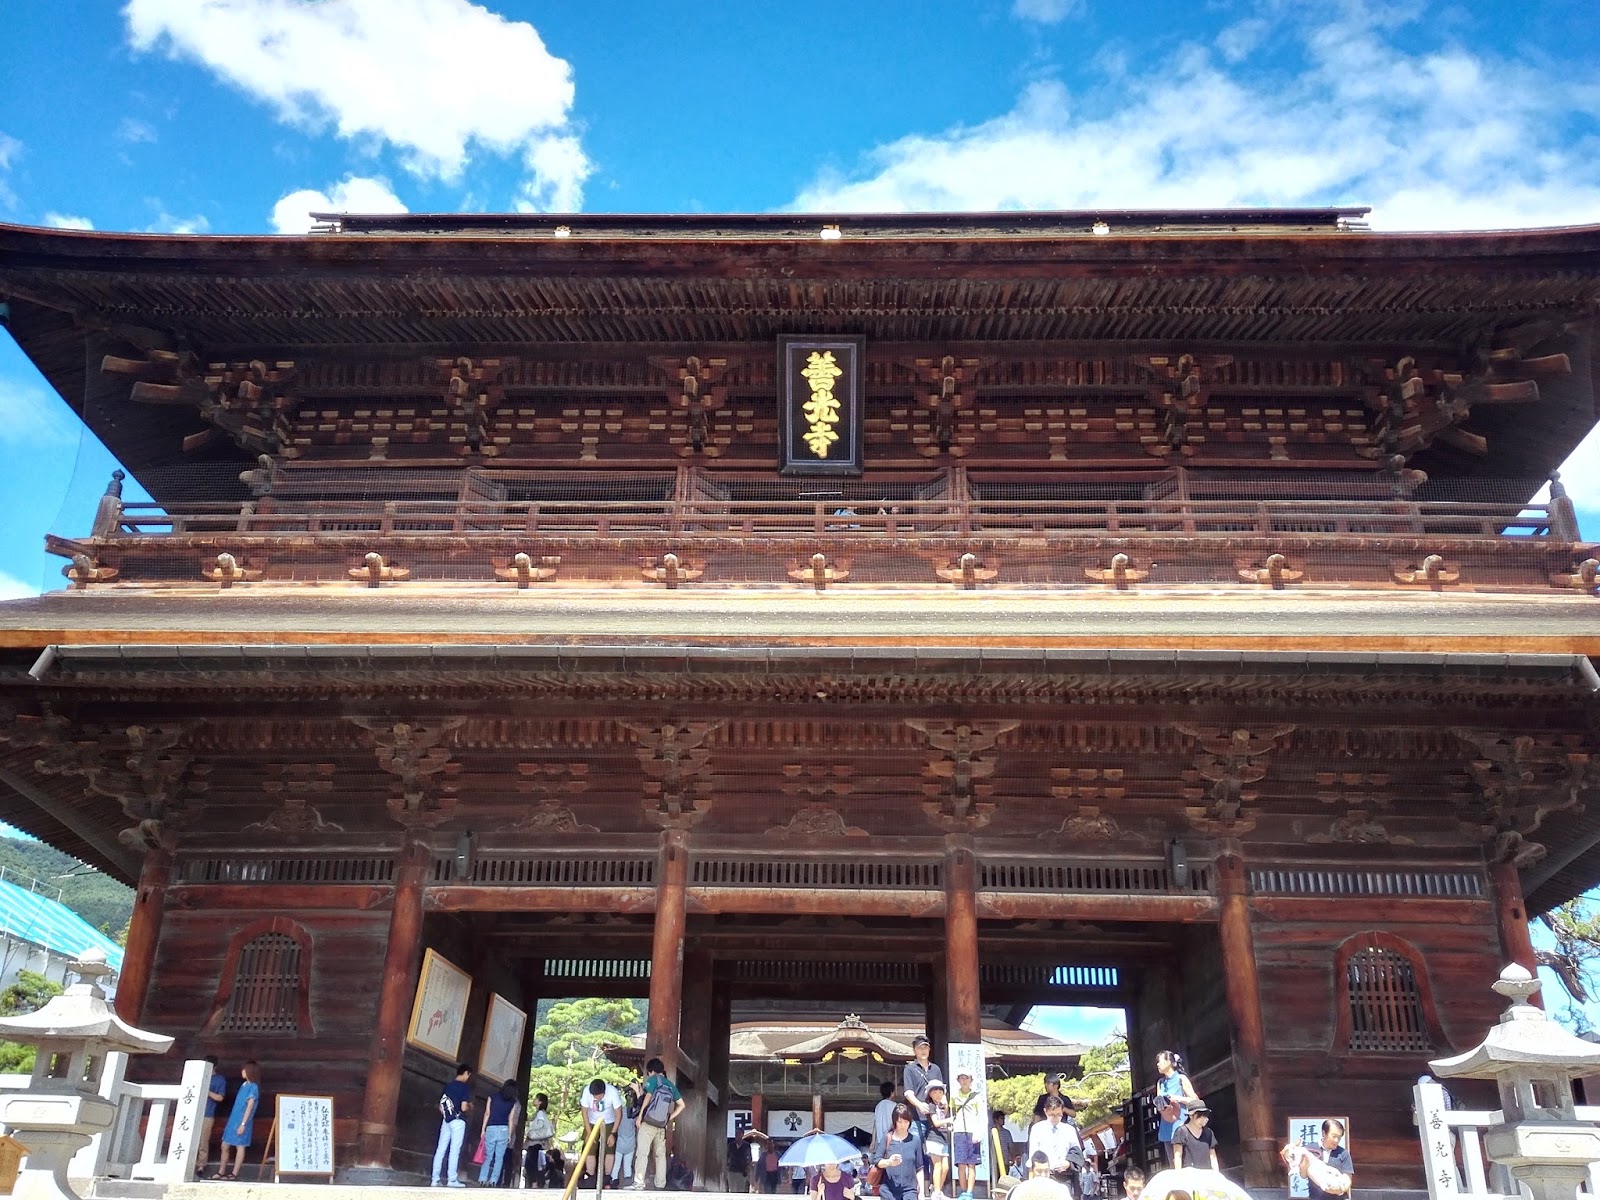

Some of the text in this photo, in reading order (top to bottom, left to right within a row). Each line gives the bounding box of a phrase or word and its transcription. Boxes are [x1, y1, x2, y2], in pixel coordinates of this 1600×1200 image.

[800, 350, 843, 459] 善光寺
[172, 1084, 196, 1160] 善光寺
[1429, 1108, 1453, 1188] 善光寺
